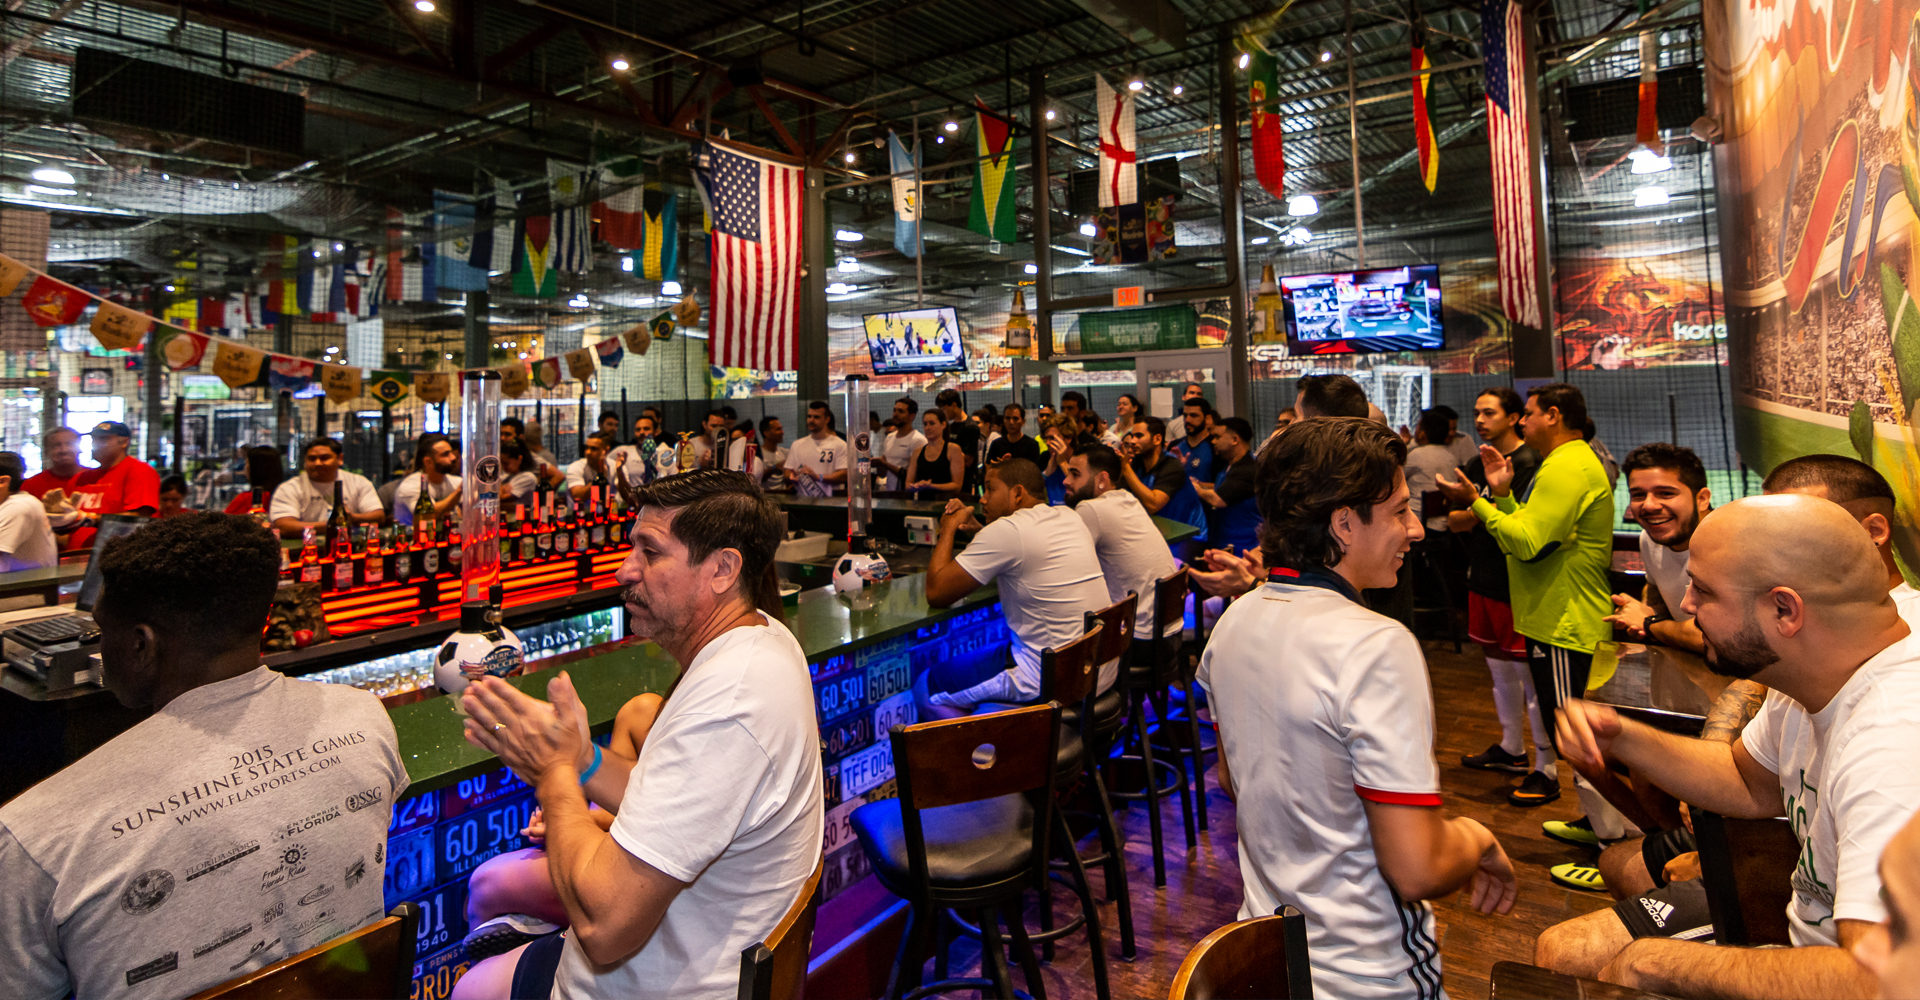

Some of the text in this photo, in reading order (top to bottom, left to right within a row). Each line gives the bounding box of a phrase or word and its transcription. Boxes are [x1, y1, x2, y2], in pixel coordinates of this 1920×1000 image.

[1118, 286, 1140, 307] EXIT
[819, 450, 834, 463] 23
[483, 658, 521, 673] SOCCER
[822, 683, 839, 711] 60
[842, 675, 864, 705] 501
[869, 674, 885, 703] 60
[887, 665, 910, 694] 501
[830, 727, 846, 754] 60
[849, 716, 870, 747] 501
[879, 710, 892, 735] 60
[229, 745, 274, 770] 2015
[111, 730, 366, 839] SUNSHINE STATE GAMES
[844, 760, 868, 791] TFF
[175, 755, 342, 826] WWW.FLASPORTS.COM
[358, 786, 383, 803] SSG
[286, 804, 340, 829] ENTERPRISE
[287, 811, 342, 837] FLORIDA
[446, 799, 529, 863] 60 501
[185, 852, 227, 877] FLORIDA
[454, 838, 522, 874] ILLINOIS 38
[1639, 897, 1666, 928] adidas
[416, 930, 449, 954] 1940
